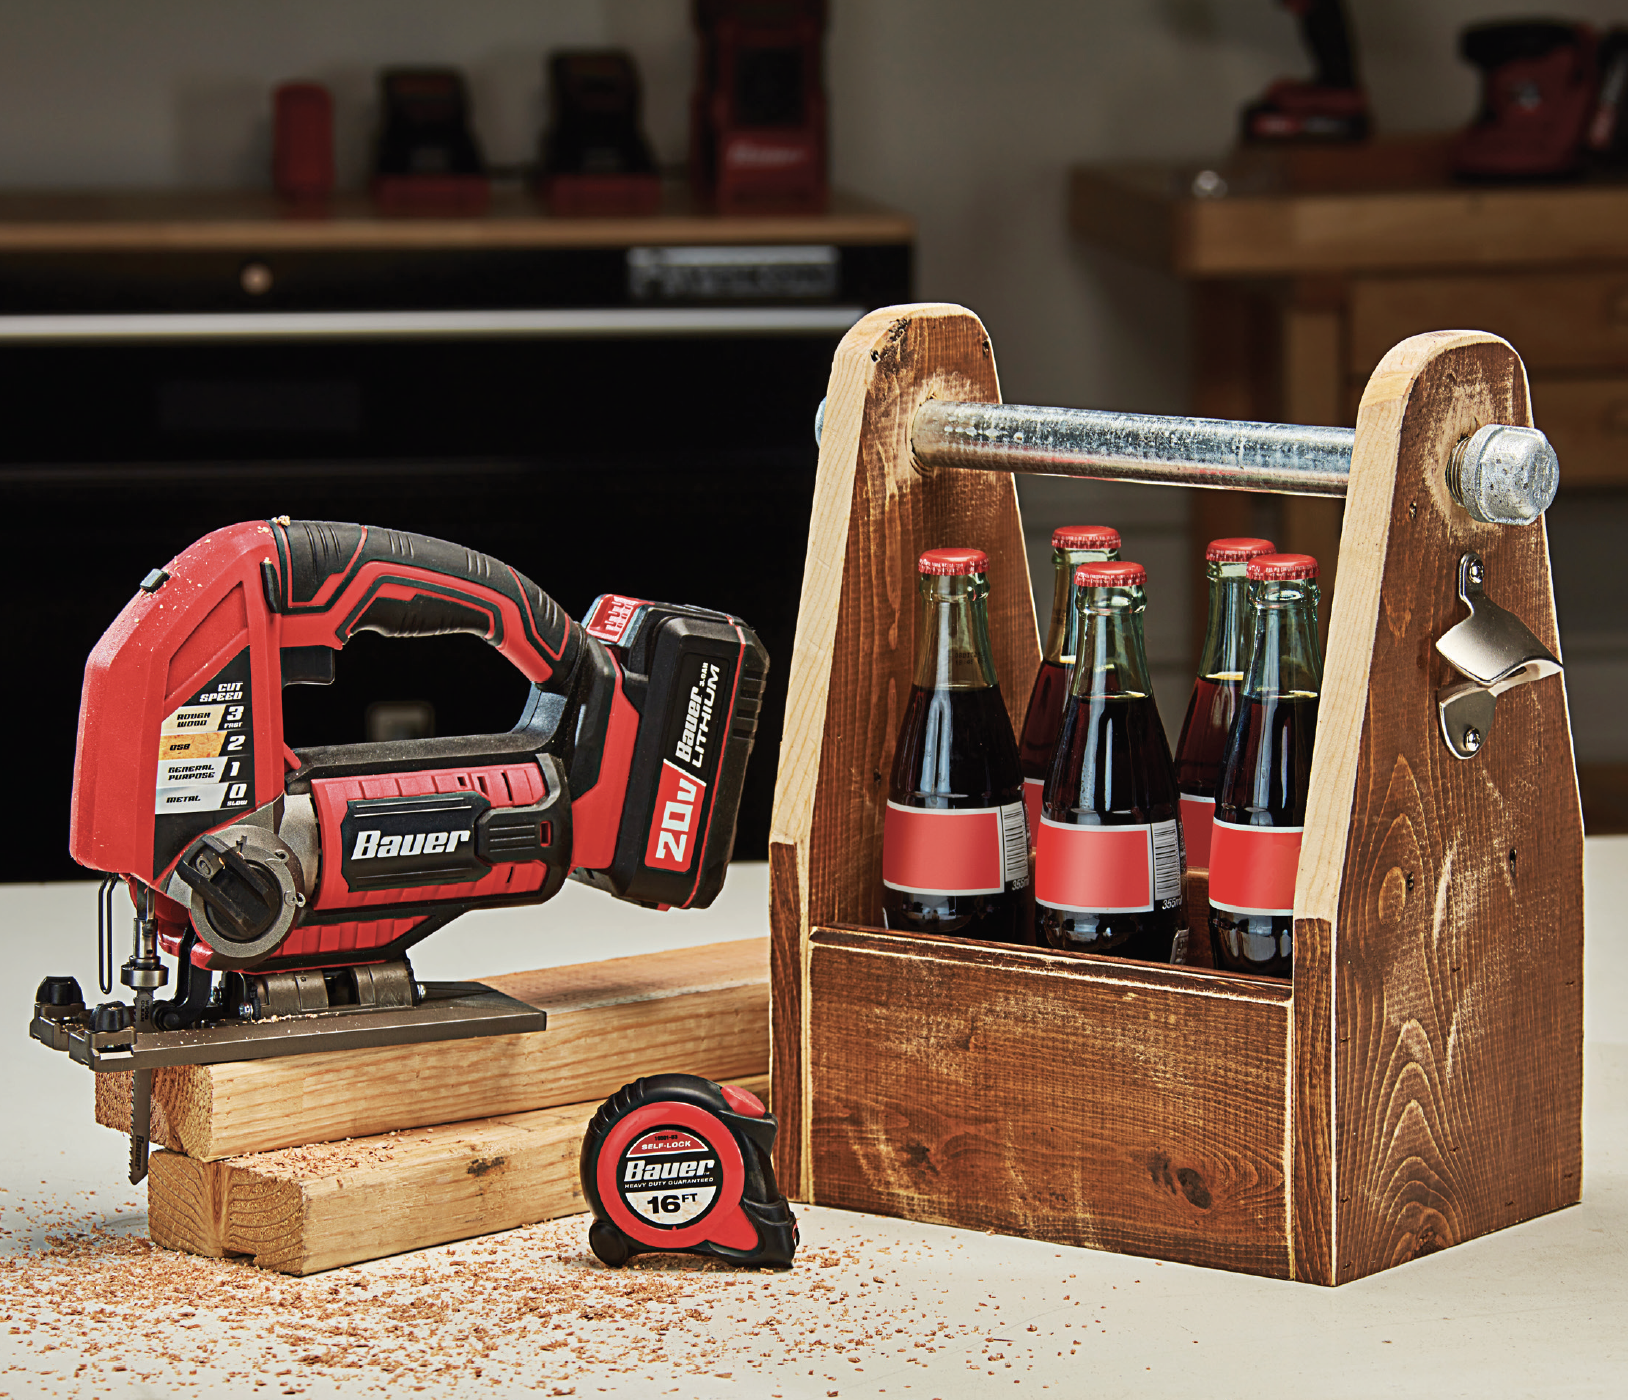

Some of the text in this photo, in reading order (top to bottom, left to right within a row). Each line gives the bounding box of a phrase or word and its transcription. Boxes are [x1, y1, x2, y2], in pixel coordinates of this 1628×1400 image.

[218, 682, 243, 692] CUT
[200, 692, 243, 702] SPEED
[177, 712, 211, 720] ROUGH
[227, 706, 244, 721] 3
[692, 664, 720, 768] LITHIUM
[177, 719, 207, 728] WOOD
[675, 686, 702, 763] Bauer
[169, 743, 191, 751] OSB
[227, 735, 246, 751] 2
[168, 764, 214, 774] GENERAL
[229, 761, 240, 777] 1
[168, 771, 215, 781] PURPOSE
[229, 783, 247, 799] 0
[166, 795, 201, 803] METAL
[351, 830, 471, 860] Bauer
[641, 1141, 691, 1150] SELF-LOCK
[624, 1160, 715, 1181] Bauer
[668, 1177, 714, 1186] GUARANTEED
[647, 1193, 698, 1214] 16 FT
